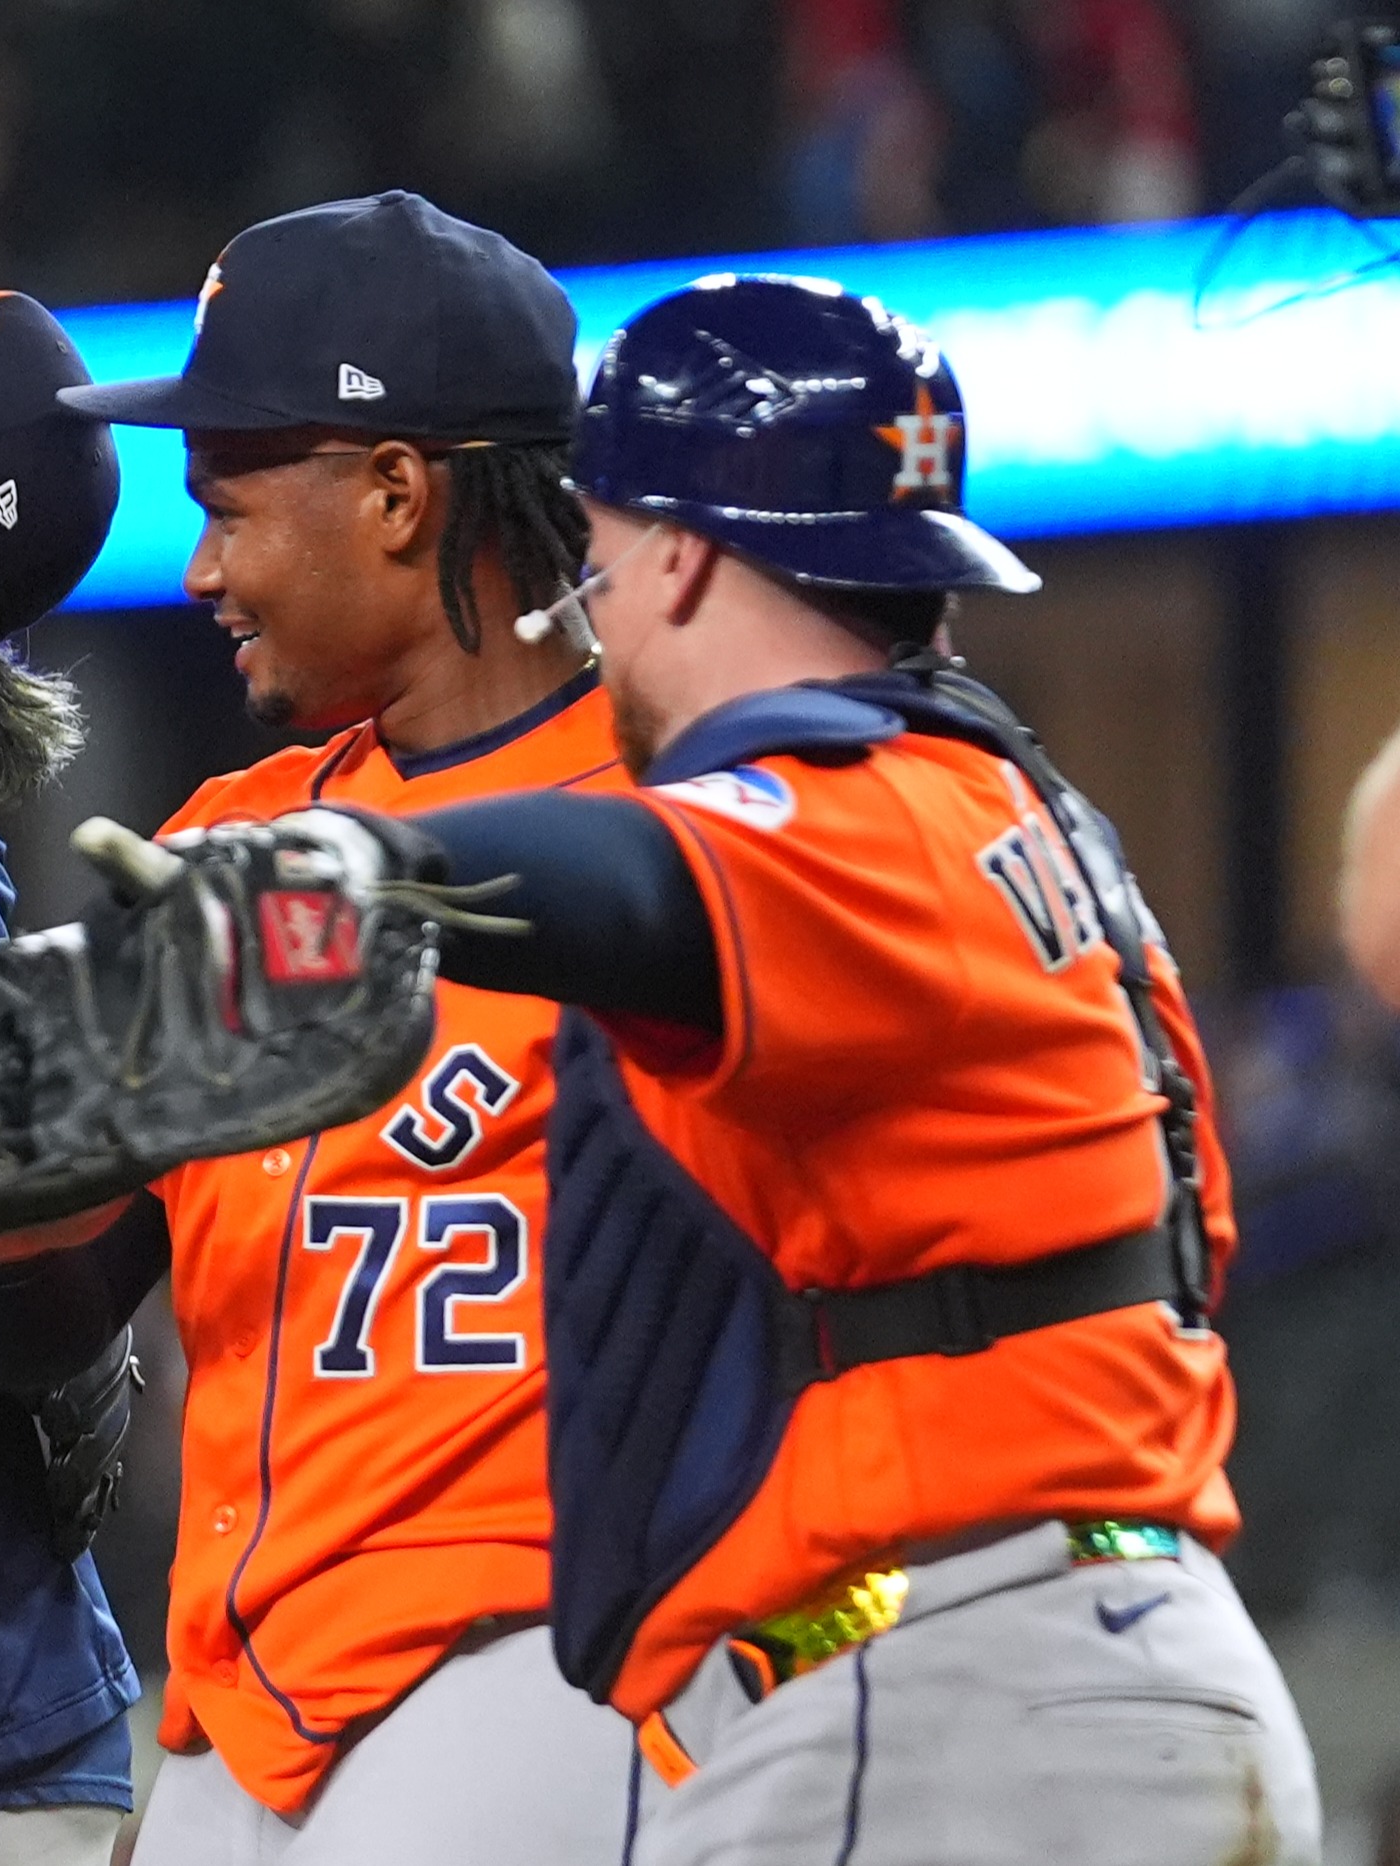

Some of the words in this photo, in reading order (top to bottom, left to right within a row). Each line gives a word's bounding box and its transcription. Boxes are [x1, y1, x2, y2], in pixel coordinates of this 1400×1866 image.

[893, 413, 950, 487] H
[381, 1043, 520, 1171] S
[303, 1192, 527, 1378] 72
